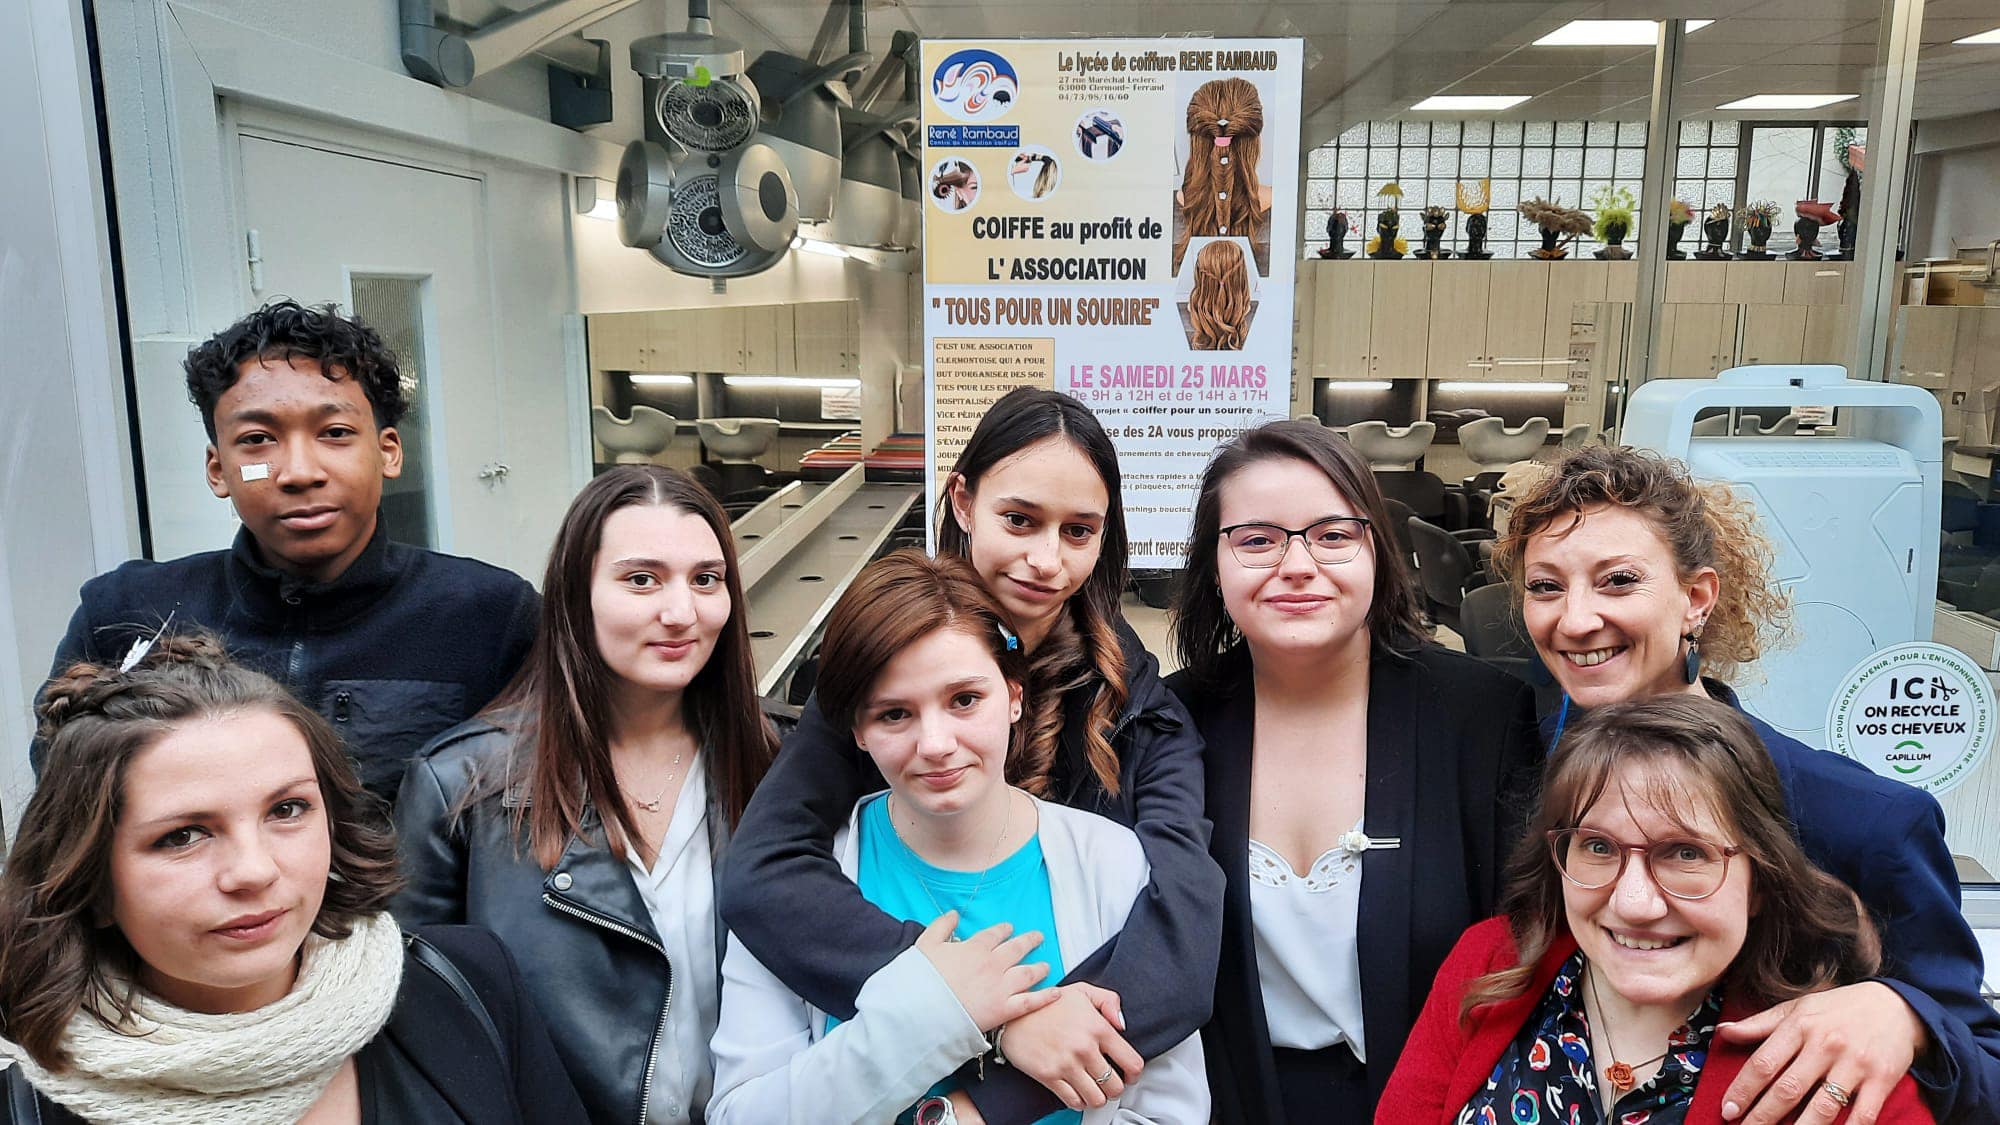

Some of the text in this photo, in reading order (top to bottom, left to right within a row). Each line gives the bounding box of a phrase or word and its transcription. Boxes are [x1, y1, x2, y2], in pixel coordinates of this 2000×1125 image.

[1058, 50, 1278, 76] Le lycée de coiffure RENE RAMBAUD
[929, 126, 1018, 139] René Rambaud
[972, 216, 1162, 244] COIFFE au profit de
[1010, 258, 1147, 280] ASSOCIATION
[944, 298, 991, 325] TOUS
[995, 298, 1043, 325] POUR
[1047, 298, 1072, 325] UN
[1076, 298, 1160, 325] SOURIRE"
[1070, 365, 1267, 388] LE SAMEDI 25 MARS
[1069, 390, 1088, 401] De
[1092, 390, 1110, 401] 9H
[1128, 390, 1154, 401] 12H
[1158, 391, 1171, 401] et
[1176, 390, 1193, 401] de
[1198, 390, 1224, 401] 14H
[1242, 390, 1268, 401] 17H
[1096, 407, 1121, 415] projet
[1132, 406, 1168, 414] coiffer
[1170, 407, 1195, 415] pour
[1215, 406, 1253, 414] sourire
[936, 425, 973, 433] ESTAING
[1123, 425, 1144, 438] des
[1147, 425, 1164, 438] 2A
[1167, 428, 1194, 438] vous
[1128, 538, 1153, 556] eront
[1893, 652, 1919, 662] POUR
[1840, 684, 1860, 711] NOTRE
[1864, 705, 1960, 718] ON RECYCLE
[1836, 714, 1845, 738] POUR
[1856, 722, 1966, 735] VOS CHEVEUX
[1978, 709, 1986, 733] POUR
[1885, 753, 1931, 761] CAPILLUM
[1962, 735, 1982, 764] NOTRE
